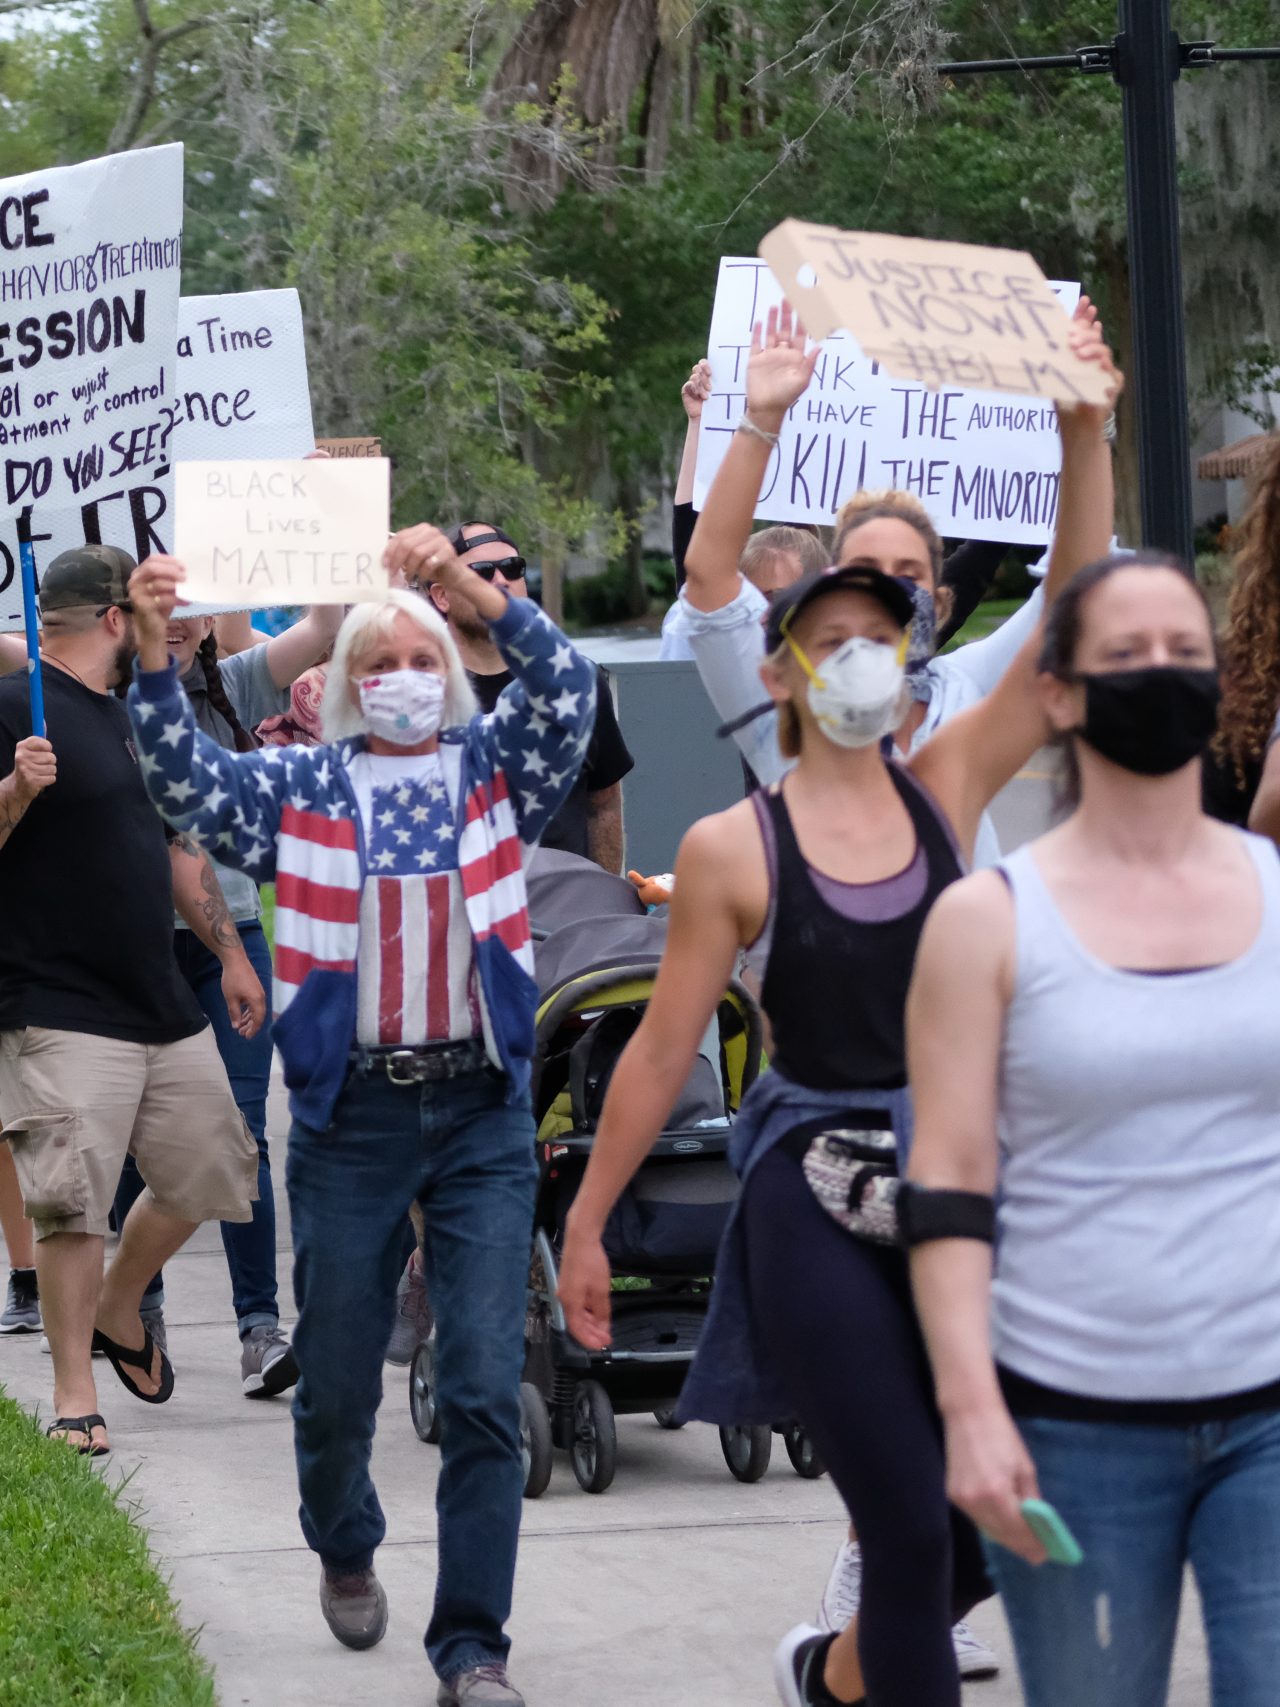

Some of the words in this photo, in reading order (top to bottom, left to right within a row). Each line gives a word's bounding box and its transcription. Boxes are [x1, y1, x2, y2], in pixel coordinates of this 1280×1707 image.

[806, 235, 1037, 302] JUSTICE
[176, 335, 194, 358] a
[196, 316, 274, 355] Time
[33, 390, 59, 409] or
[71, 366, 110, 405] unjust
[83, 404, 99, 425] or
[104, 366, 164, 412] control
[807, 399, 877, 428] HAVE
[890, 387, 965, 441] THE
[5, 456, 53, 505] DO
[62, 443, 104, 495] YOU
[108, 407, 175, 478] SEE?
[206, 470, 309, 500] BLACK
[881, 458, 951, 499] THE
[212, 545, 374, 587] MATTER
